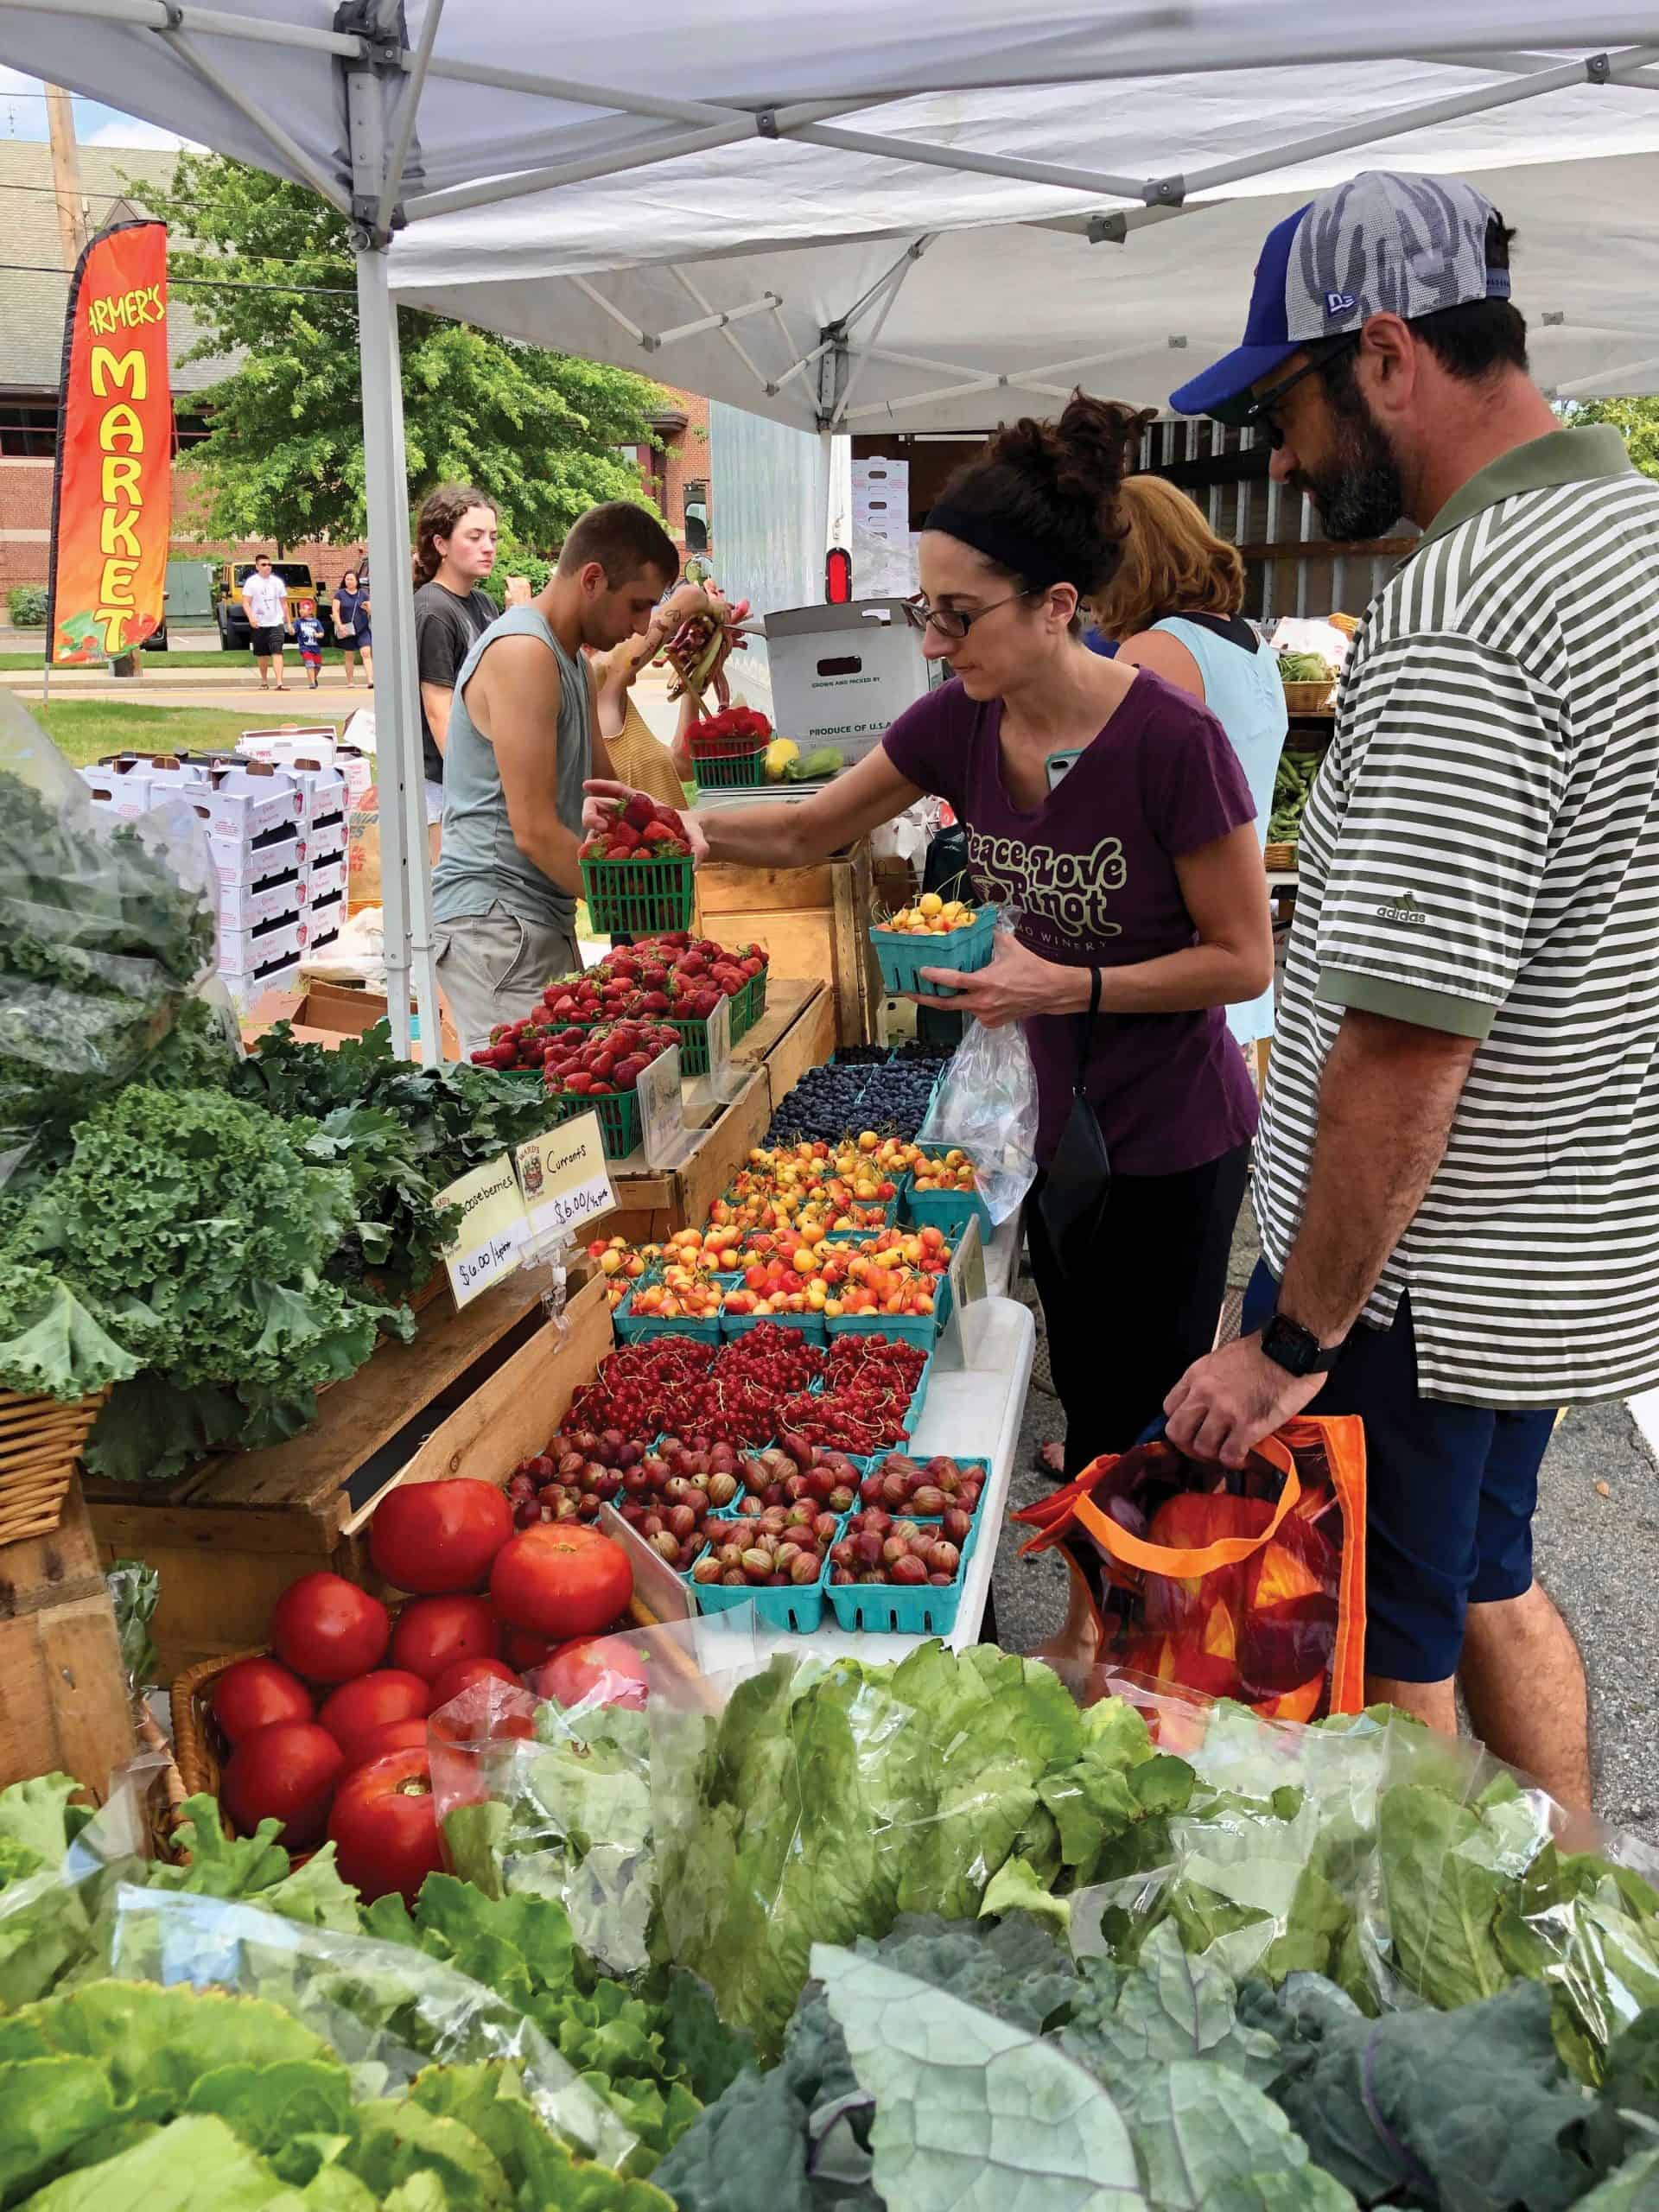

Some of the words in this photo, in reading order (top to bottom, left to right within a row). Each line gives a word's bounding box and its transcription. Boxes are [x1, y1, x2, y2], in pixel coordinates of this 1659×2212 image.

[89, 283, 166, 336] ARMER'S
[90, 345, 147, 655] MARKET
[809, 725, 851, 736] PRODUCE
[1028, 837, 1127, 889] Love
[985, 864, 1122, 937] Pinot
[1376, 906, 1426, 924] adidas
[547, 1144, 588, 1173] Currants
